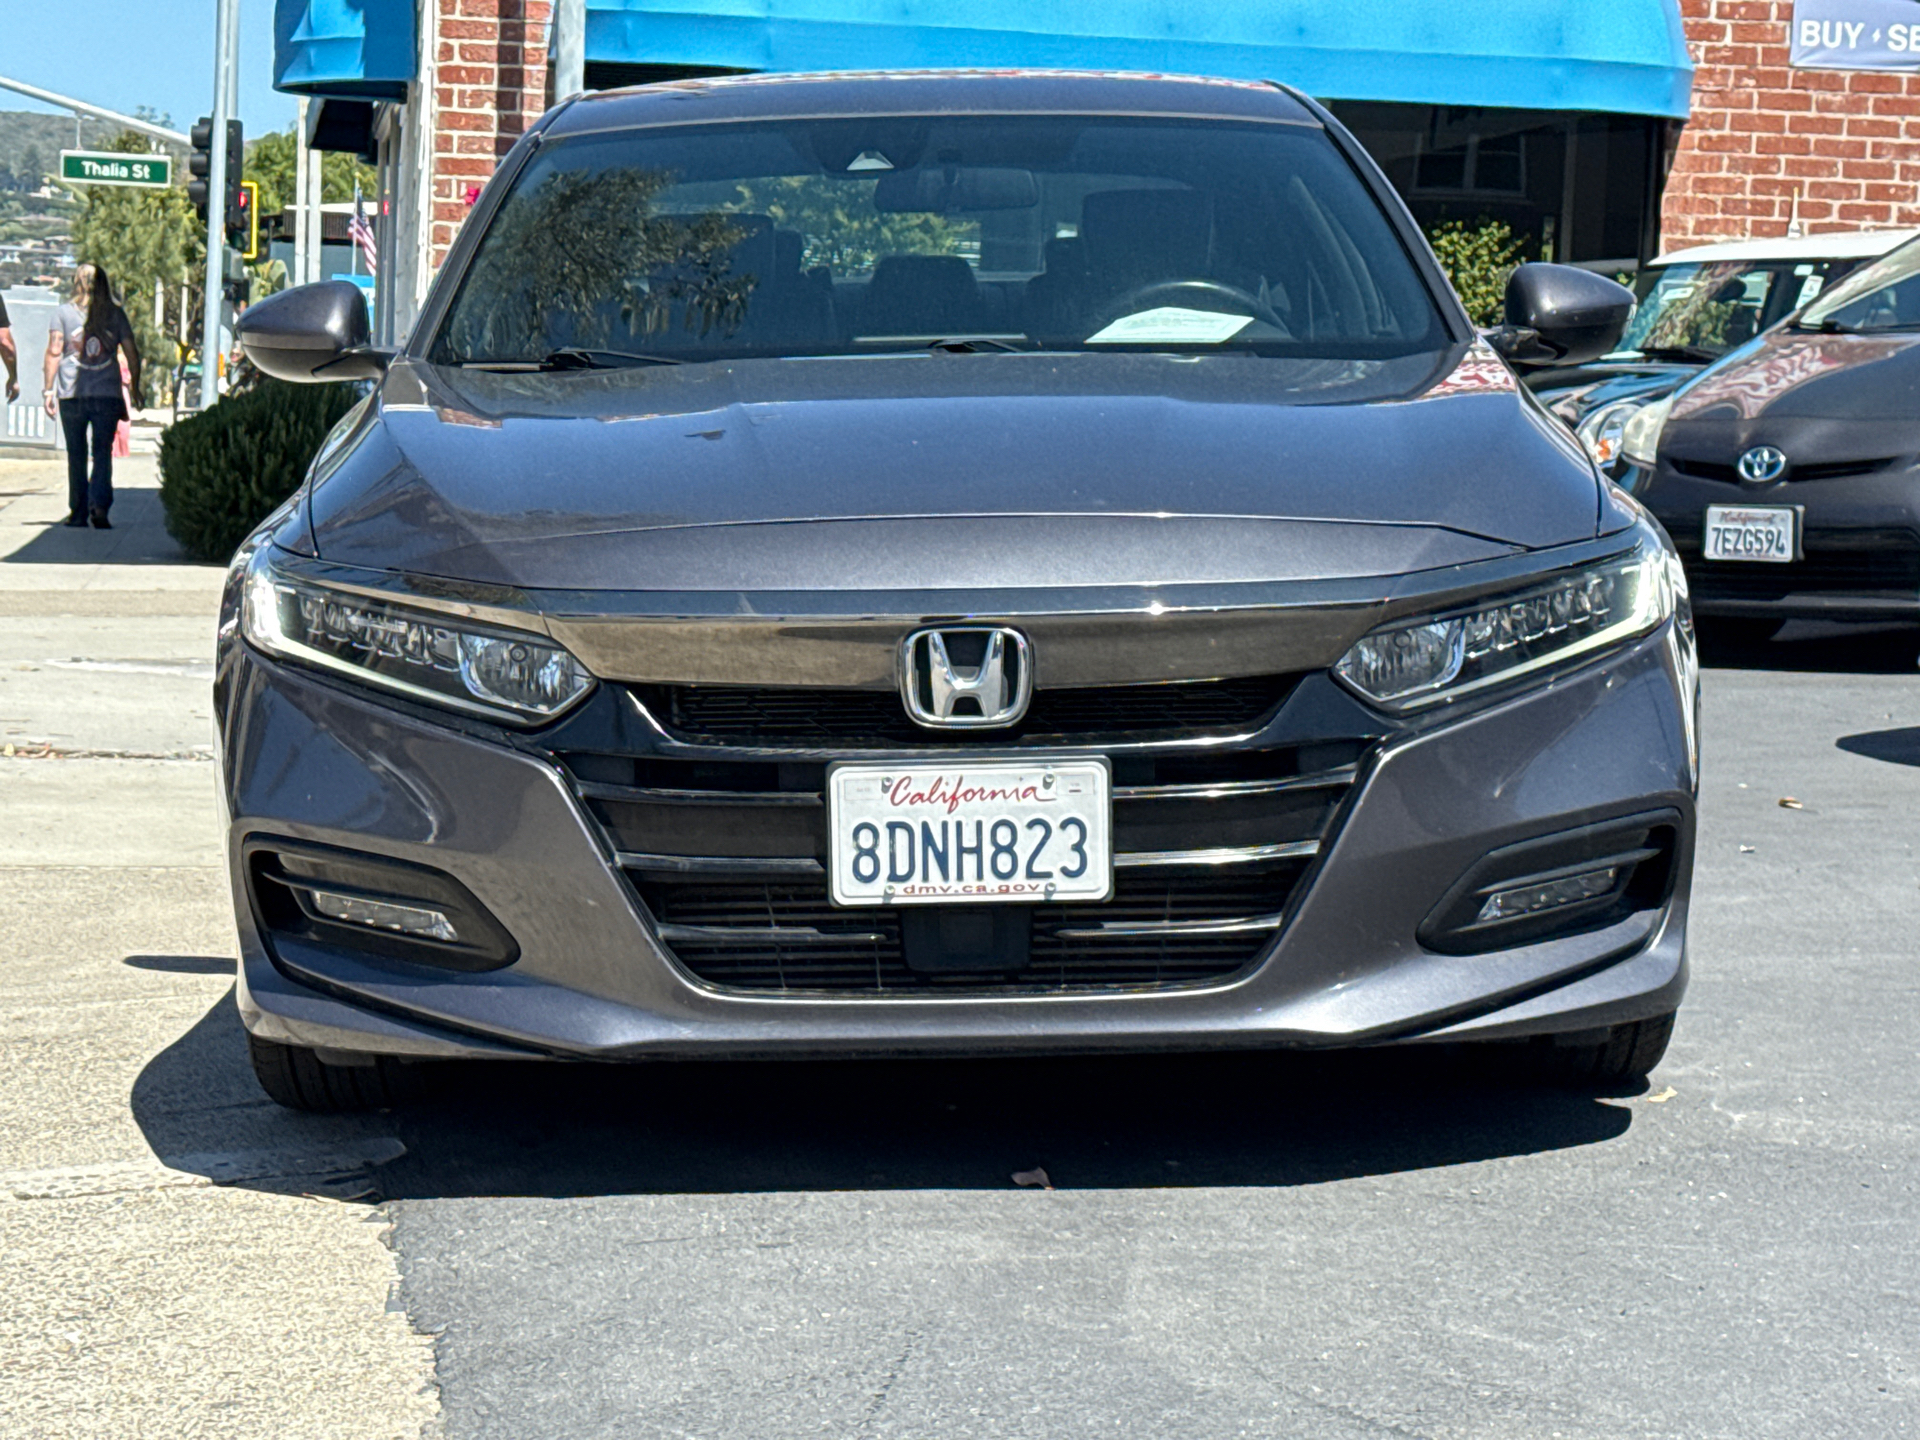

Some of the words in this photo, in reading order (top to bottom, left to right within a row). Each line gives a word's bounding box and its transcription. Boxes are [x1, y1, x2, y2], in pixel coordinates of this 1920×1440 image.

[1800, 20, 1865, 49] BUY
[1887, 23, 1920, 52] SE
[81, 160, 129, 178] Thalia
[131, 163, 151, 179] St
[1711, 527, 1786, 555] 7EZG594
[889, 775, 1056, 814] California
[851, 816, 1088, 883] 8DNH823
[902, 882, 1040, 894] dmv.ca.gov
